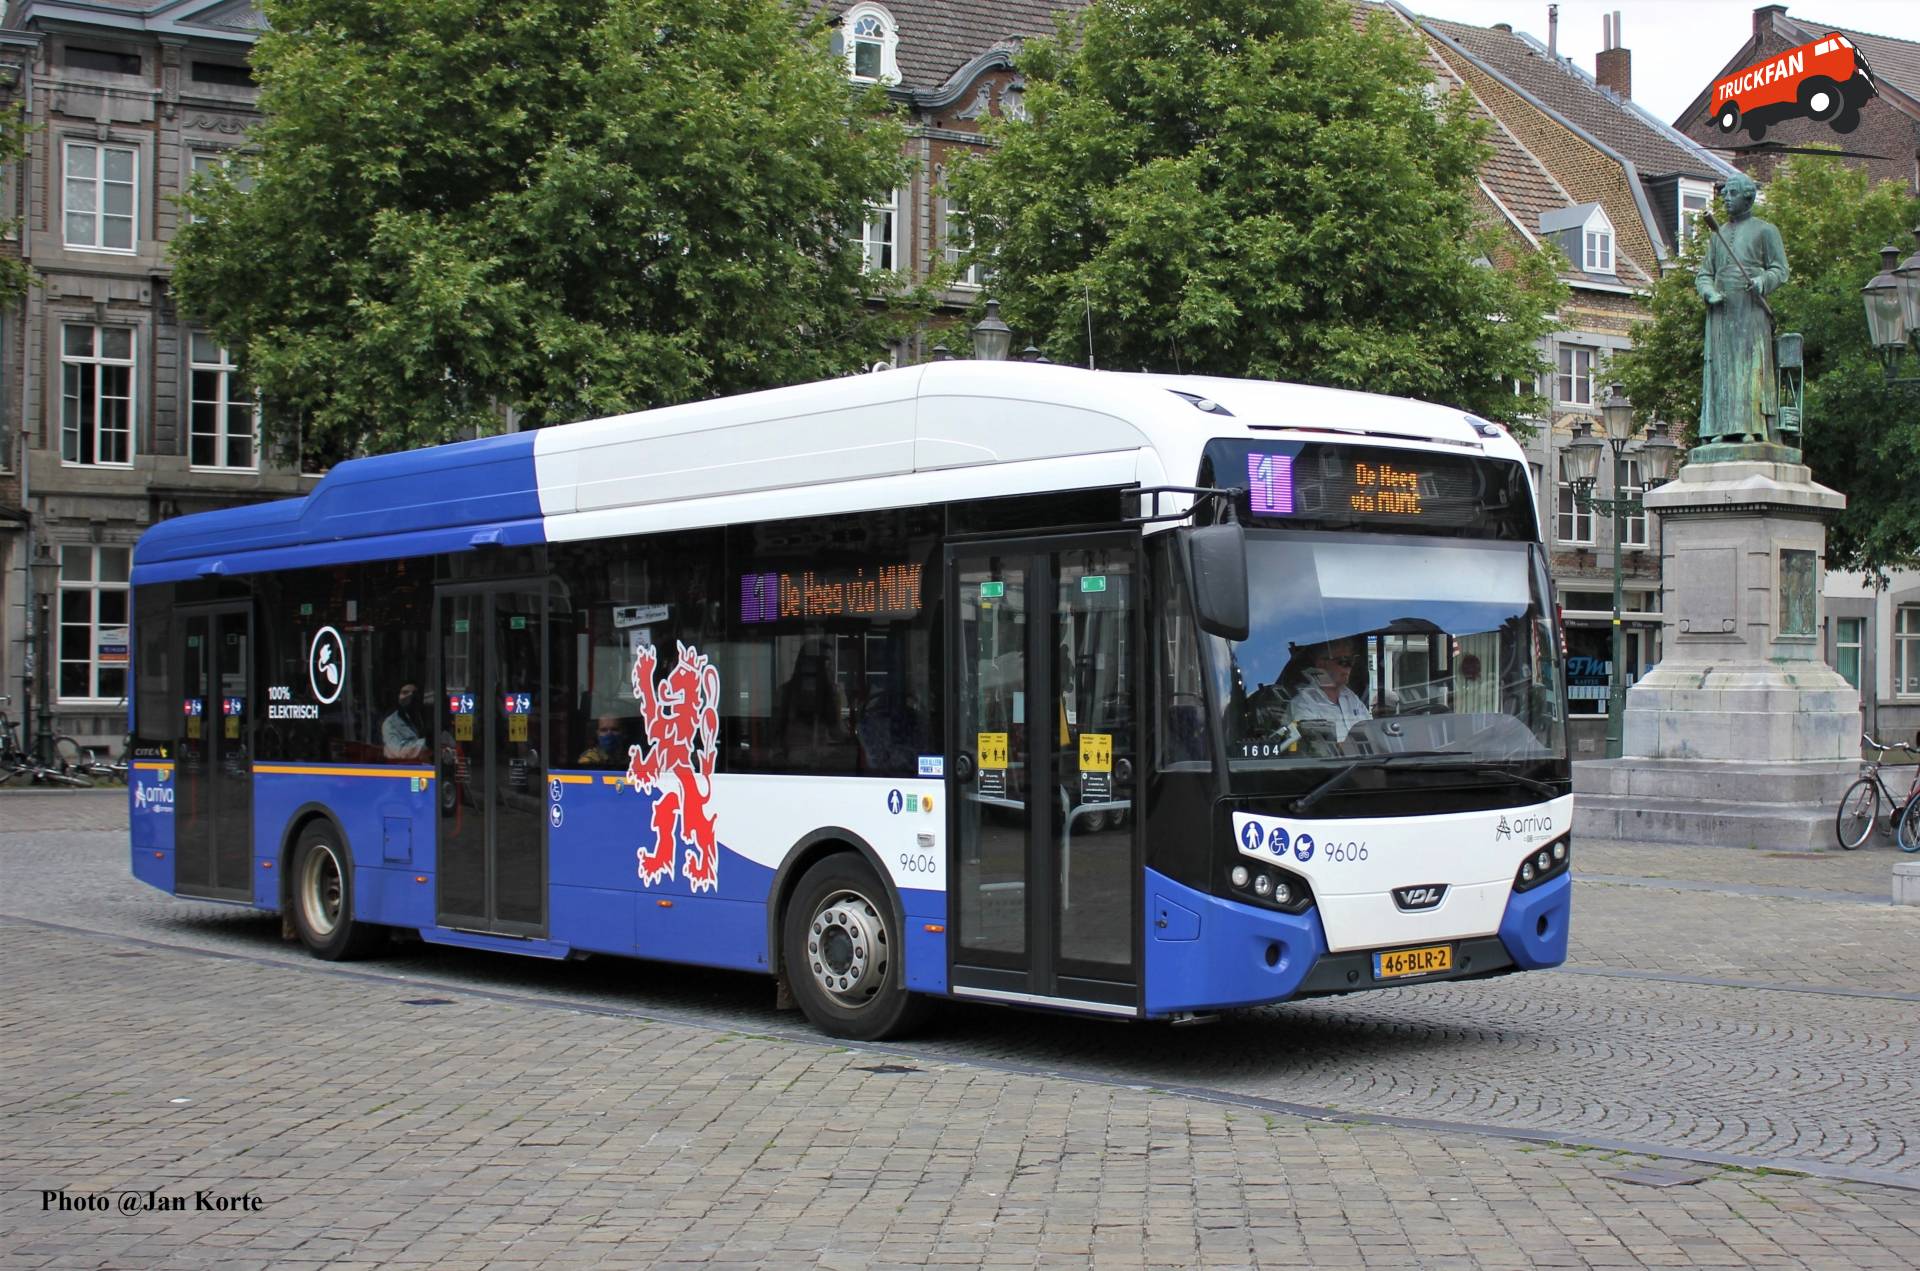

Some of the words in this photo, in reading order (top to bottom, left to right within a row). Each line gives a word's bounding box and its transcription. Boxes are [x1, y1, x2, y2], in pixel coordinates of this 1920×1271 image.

[1258, 457, 1273, 507] 1
[1356, 464, 1376, 486] De
[1351, 491, 1374, 512] via
[1377, 491, 1422, 514] MUMC
[781, 574, 799, 617] De
[847, 568, 875, 613] via
[268, 686, 291, 700] 100%
[268, 705, 319, 719] ELEKTRISCH
[1242, 744, 1280, 757] 1604
[146, 783, 174, 803] arriva
[1513, 813, 1552, 833] arriva
[1325, 841, 1369, 862] 9606
[900, 853, 936, 873] 9606
[1400, 888, 1439, 904] VDL
[1385, 950, 1446, 973] 46-BLR-2
